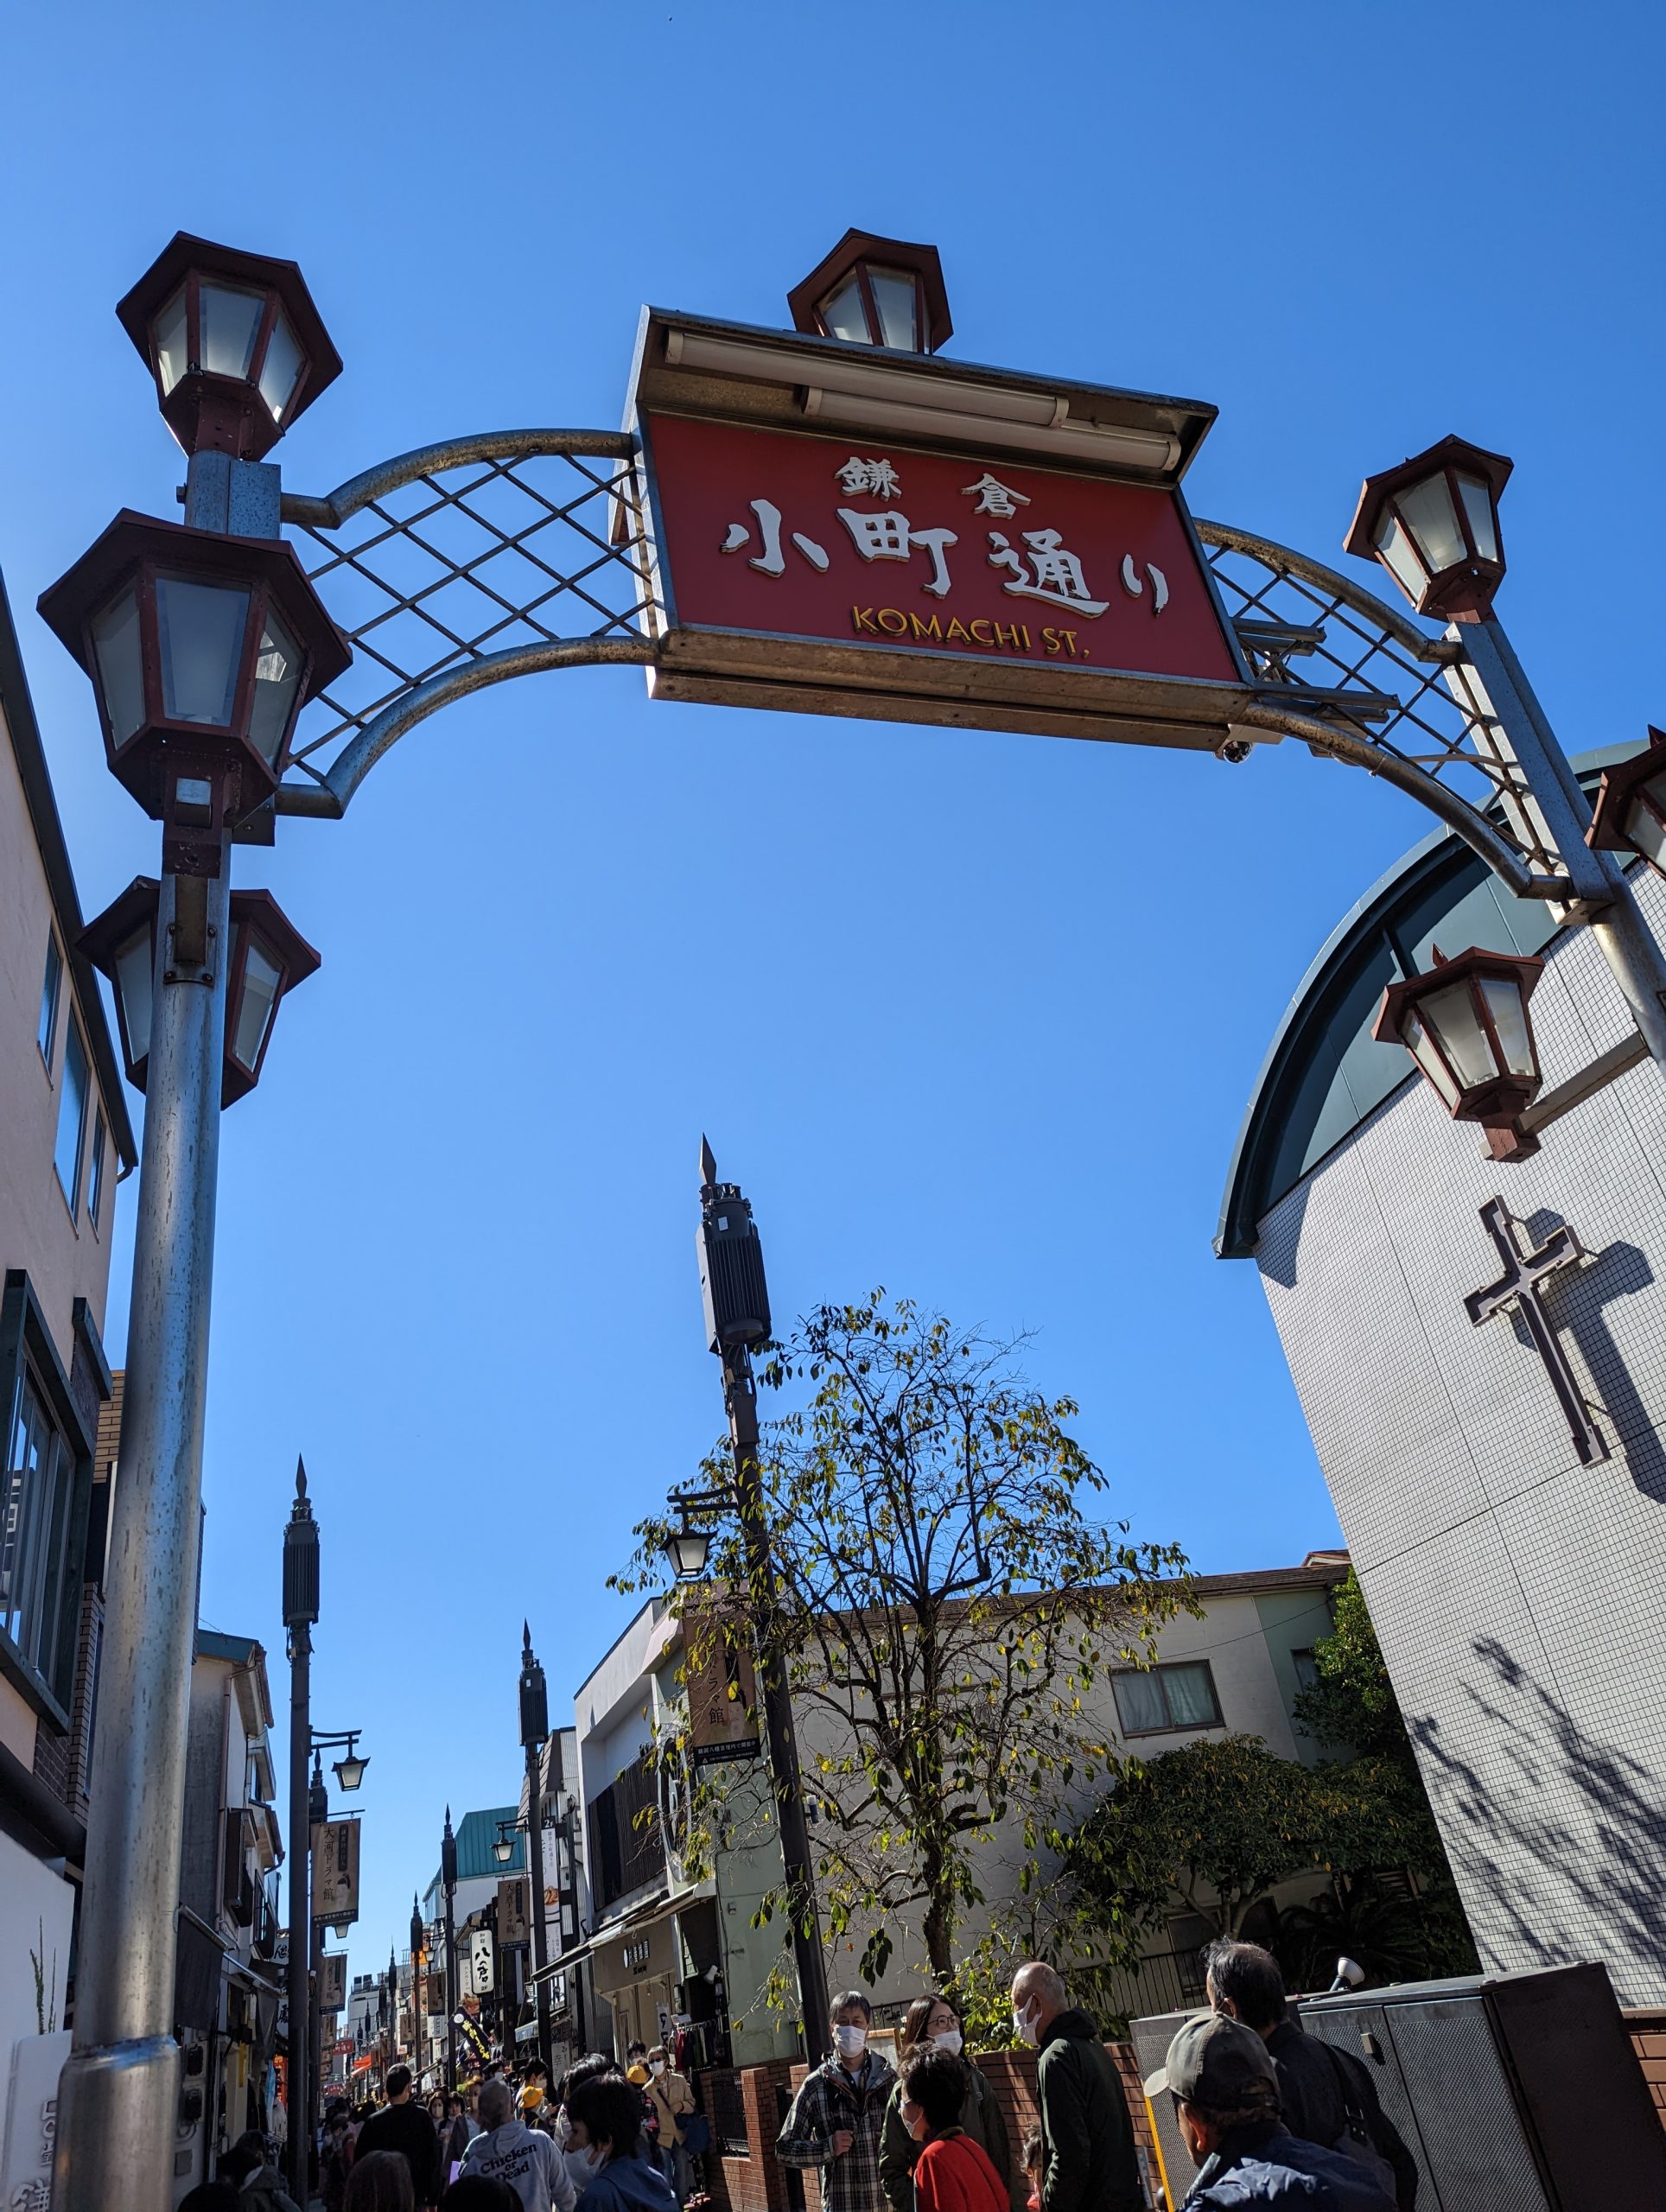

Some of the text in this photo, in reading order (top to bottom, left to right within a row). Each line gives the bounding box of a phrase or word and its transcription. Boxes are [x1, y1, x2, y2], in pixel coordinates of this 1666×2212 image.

[834, 455, 1031, 520] 鎌倉
[719, 499, 1169, 620] 小町通り
[852, 605, 1091, 658] KOMACHI ST.
[322, 1826, 335, 1901] 大河ドラマ館
[480, 2144, 537, 2175] Chicken
[505, 2161, 518, 2171] or
